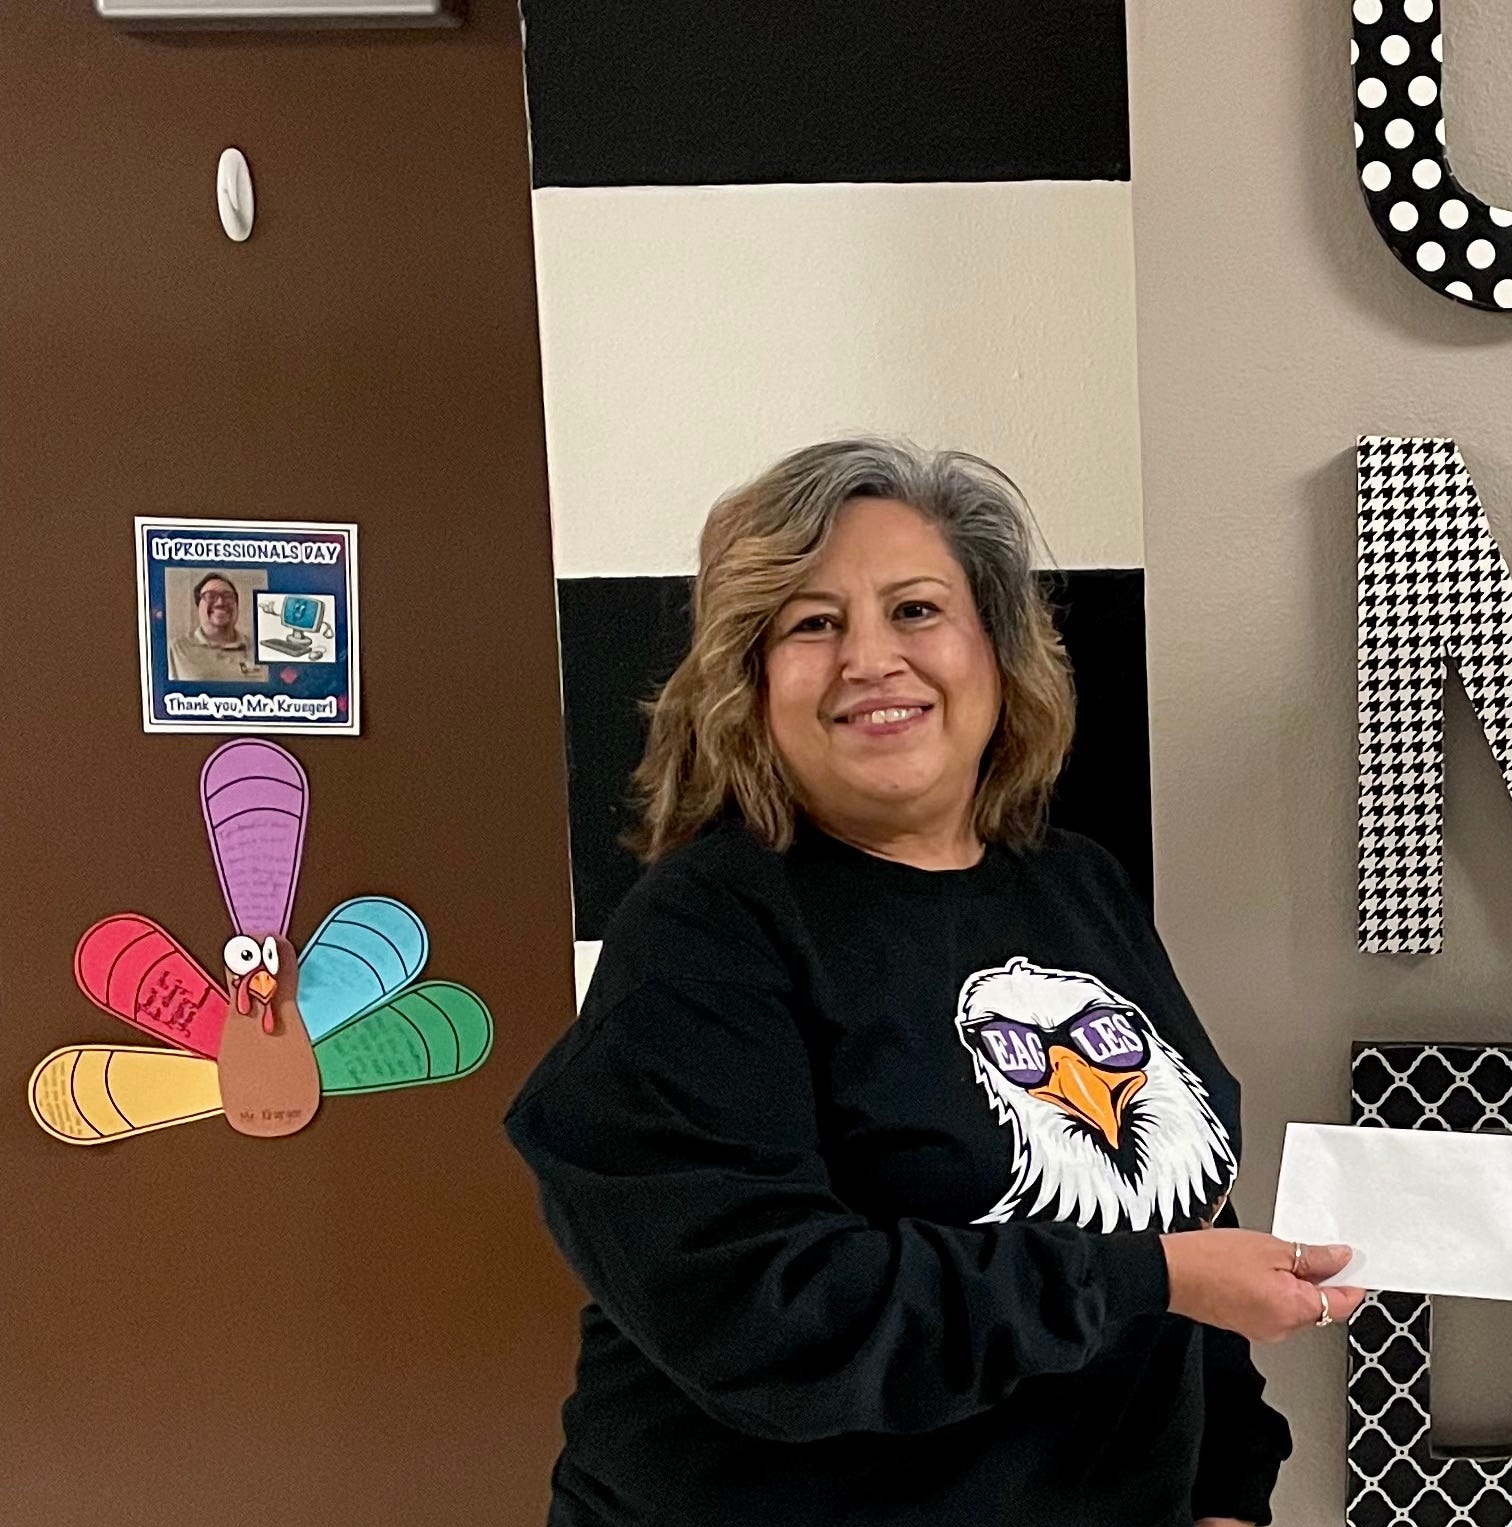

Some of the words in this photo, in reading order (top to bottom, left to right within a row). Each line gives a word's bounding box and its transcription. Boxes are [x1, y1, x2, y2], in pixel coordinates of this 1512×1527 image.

[155, 541, 169, 556] IT
[174, 542, 299, 559] PROFESSIONALS
[304, 545, 338, 561] DAY
[168, 697, 210, 712] Thank
[246, 698, 274, 713] Mr.
[277, 699, 333, 716] Krueger!
